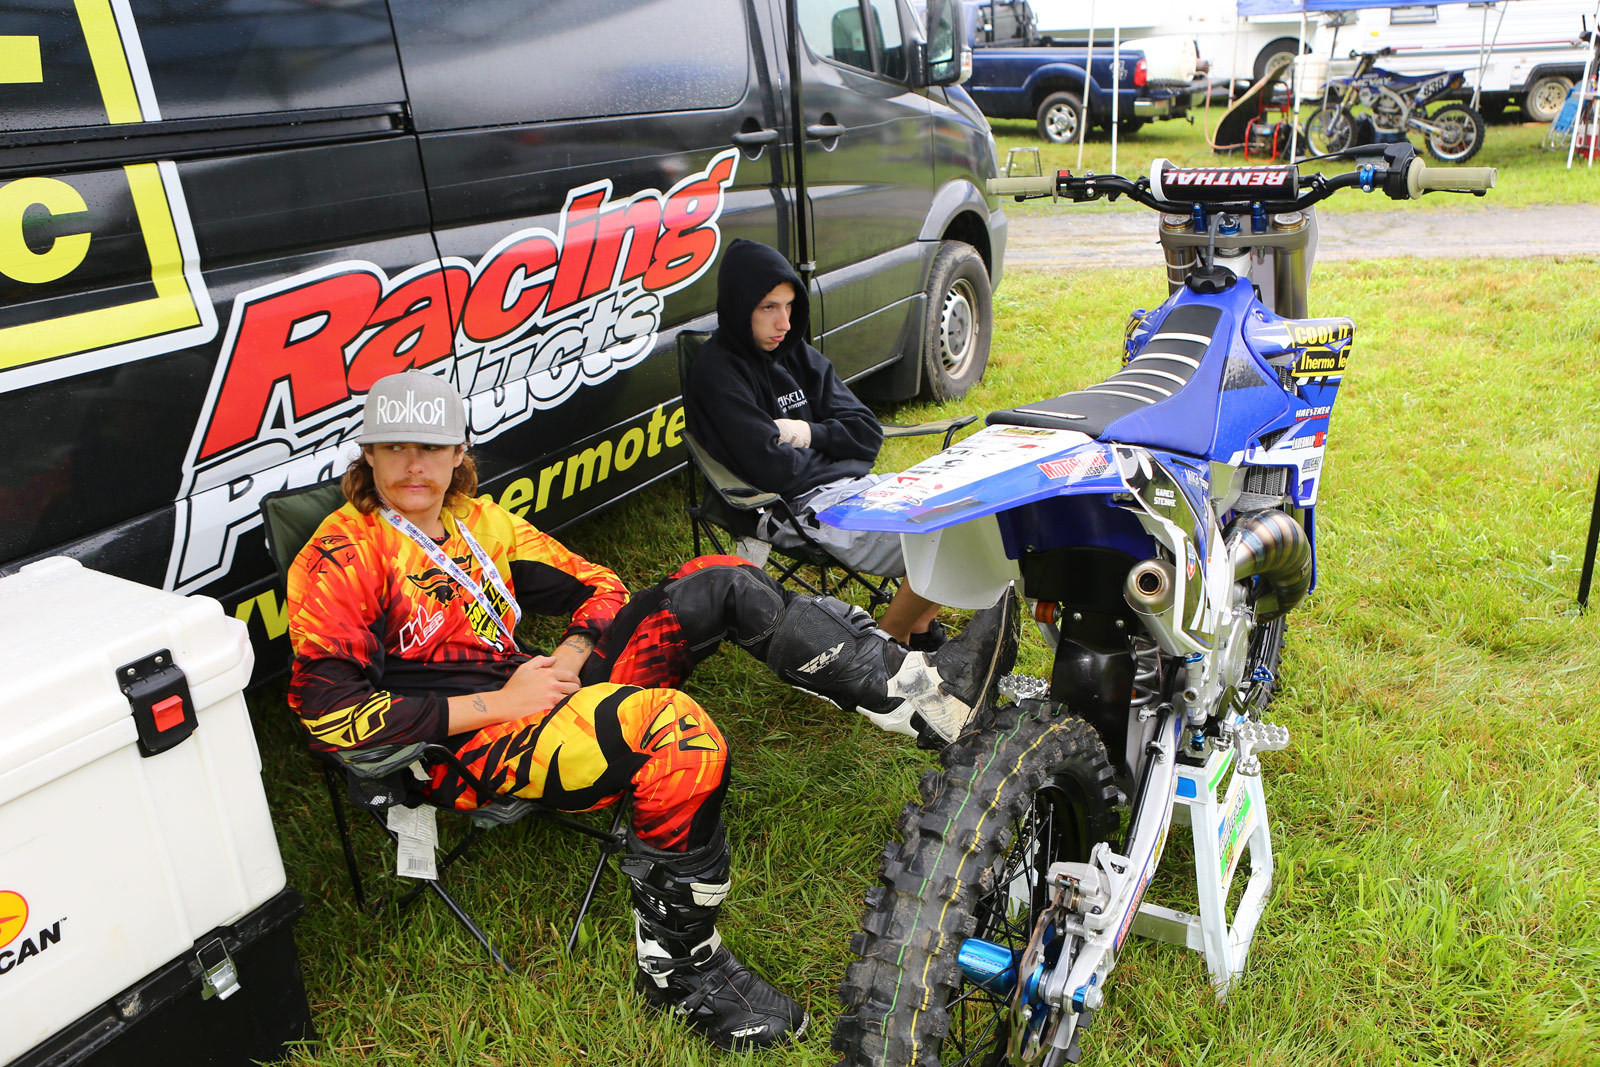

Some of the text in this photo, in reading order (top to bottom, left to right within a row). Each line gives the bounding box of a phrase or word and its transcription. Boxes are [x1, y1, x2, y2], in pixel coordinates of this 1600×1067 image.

[1163, 170, 1289, 186] RENTHAL
[196, 153, 737, 461] Racing
[1294, 325, 1336, 345] COOL
[1300, 351, 1336, 371] Thermo
[480, 402, 686, 518] ermote
